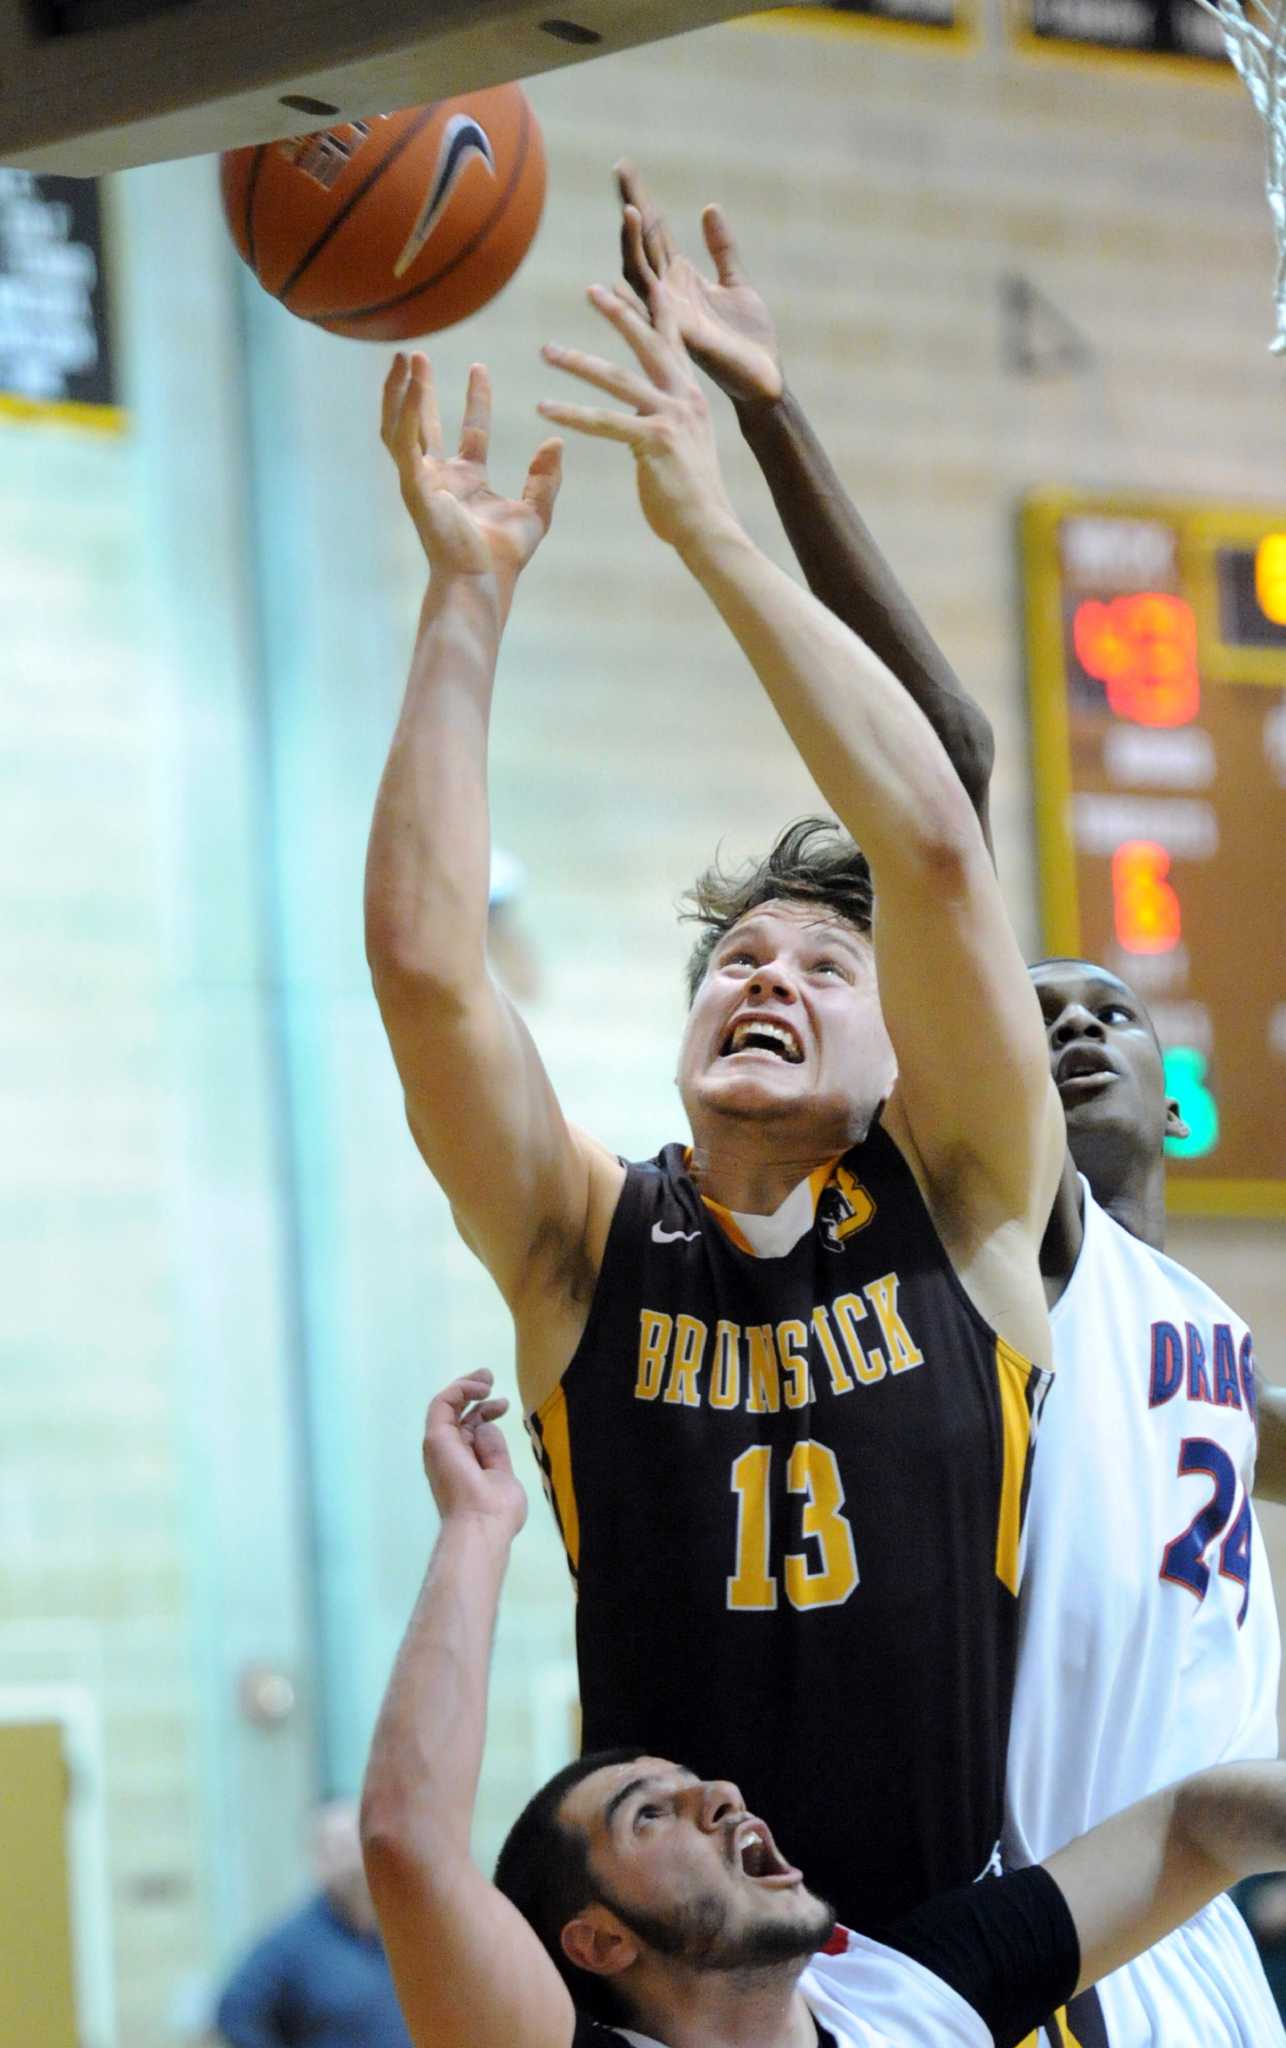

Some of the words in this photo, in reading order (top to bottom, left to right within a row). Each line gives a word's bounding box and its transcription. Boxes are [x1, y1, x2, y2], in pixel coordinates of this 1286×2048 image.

[634, 1271, 925, 1414] BRUNSICK
[726, 1438, 860, 1612] 13
[1160, 1436, 1252, 1631] 24
